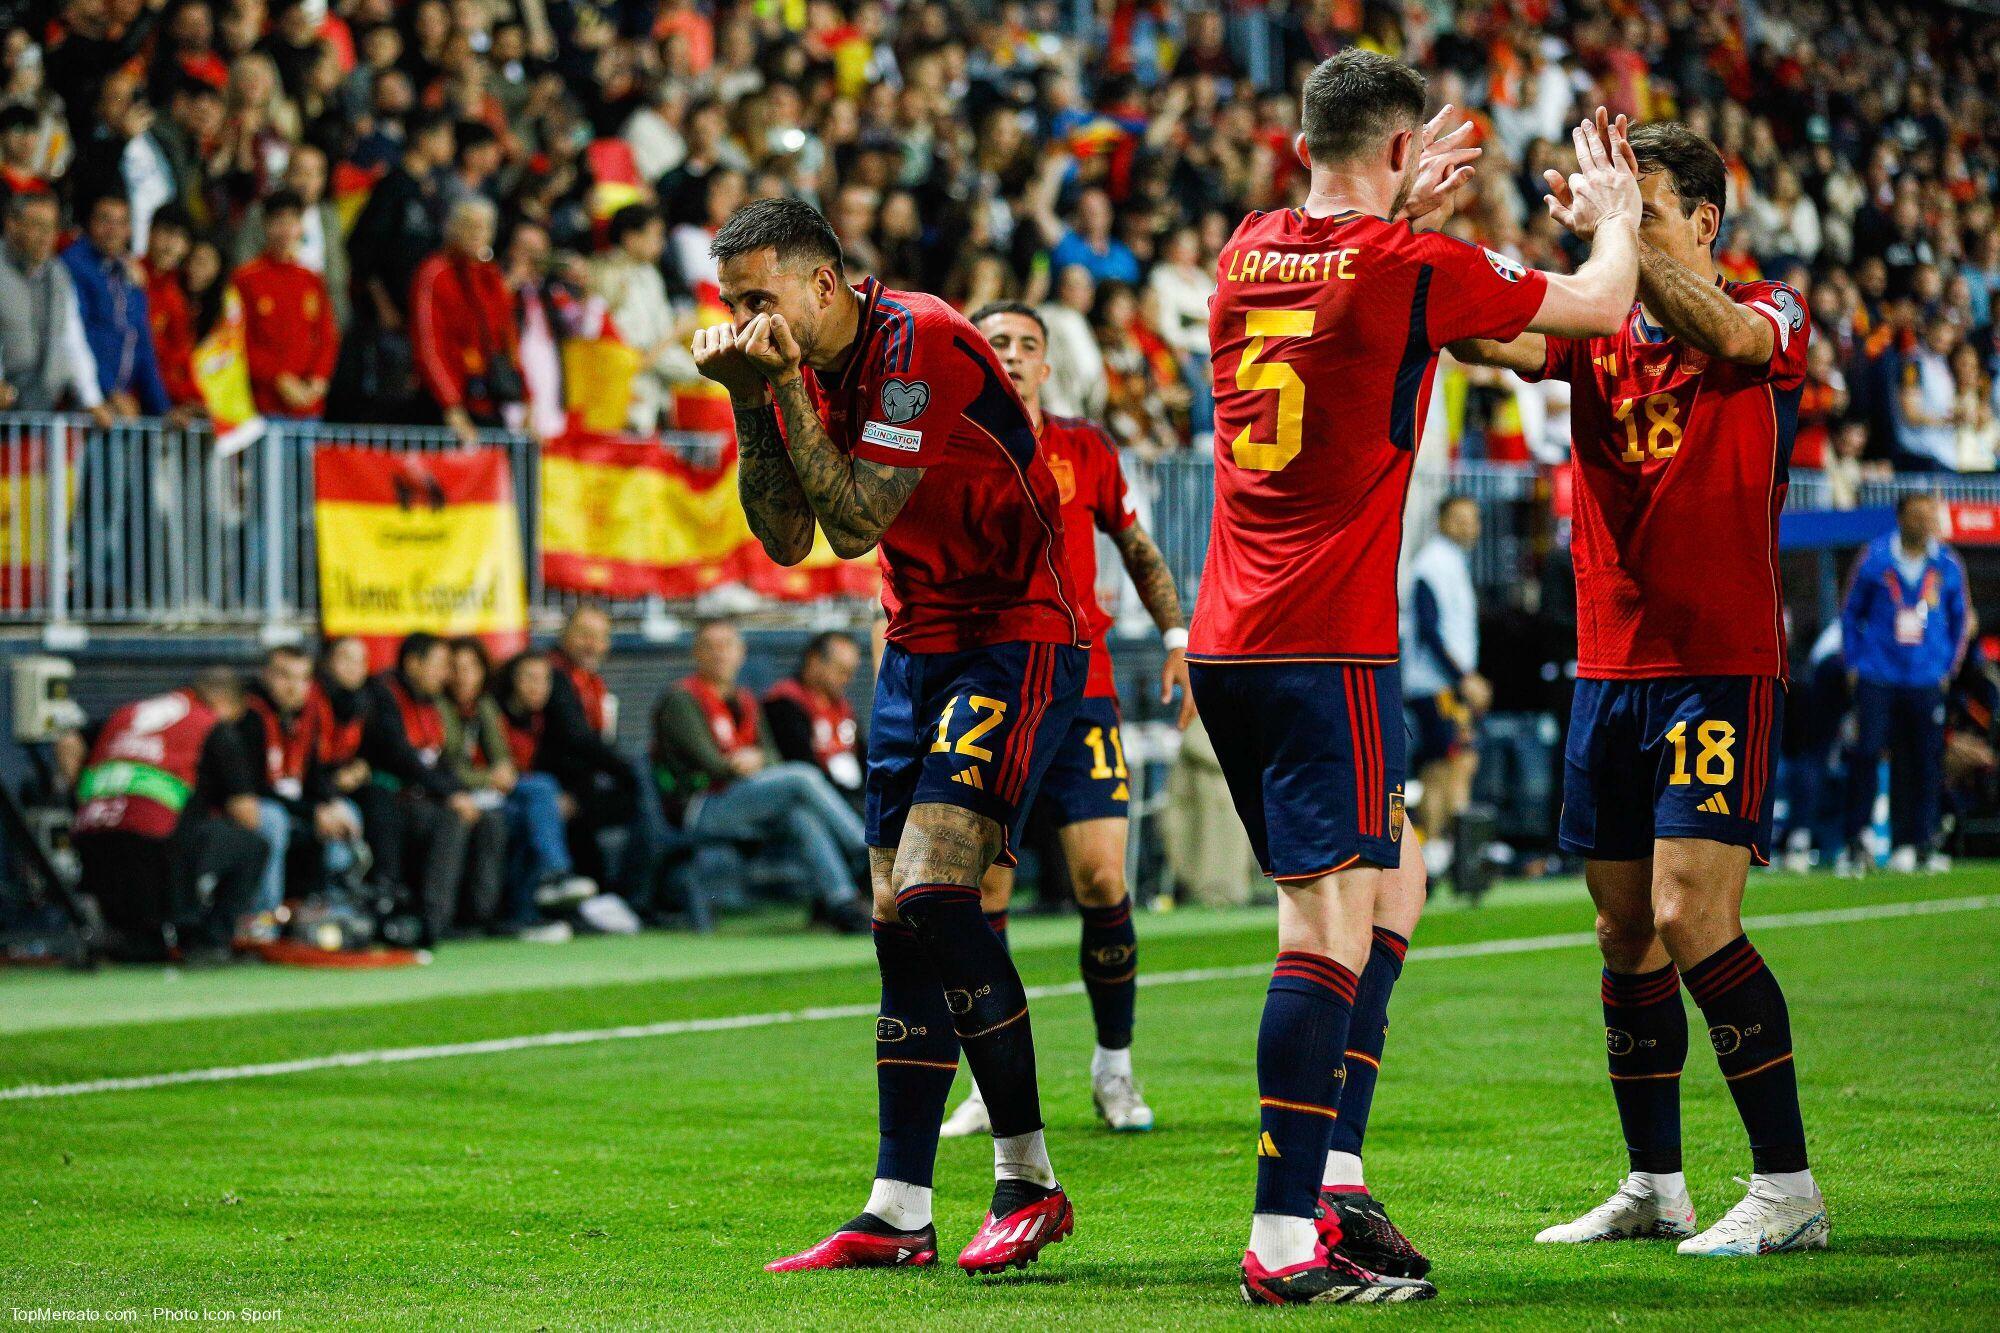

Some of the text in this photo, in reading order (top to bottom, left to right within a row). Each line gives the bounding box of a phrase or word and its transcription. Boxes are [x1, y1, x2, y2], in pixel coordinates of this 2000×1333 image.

[1227, 248, 1360, 283] LAPORTE
[1232, 310, 1317, 472] 5
[863, 427, 919, 445] FOUNDATION
[1616, 393, 1683, 463] 18
[930, 695, 1008, 763] 12
[1084, 726, 1128, 780] 11
[1665, 720, 1736, 786] 18
[974, 985, 991, 998] 09
[910, 1026, 927, 1036] 09
[1744, 1023, 1761, 1037] 09
